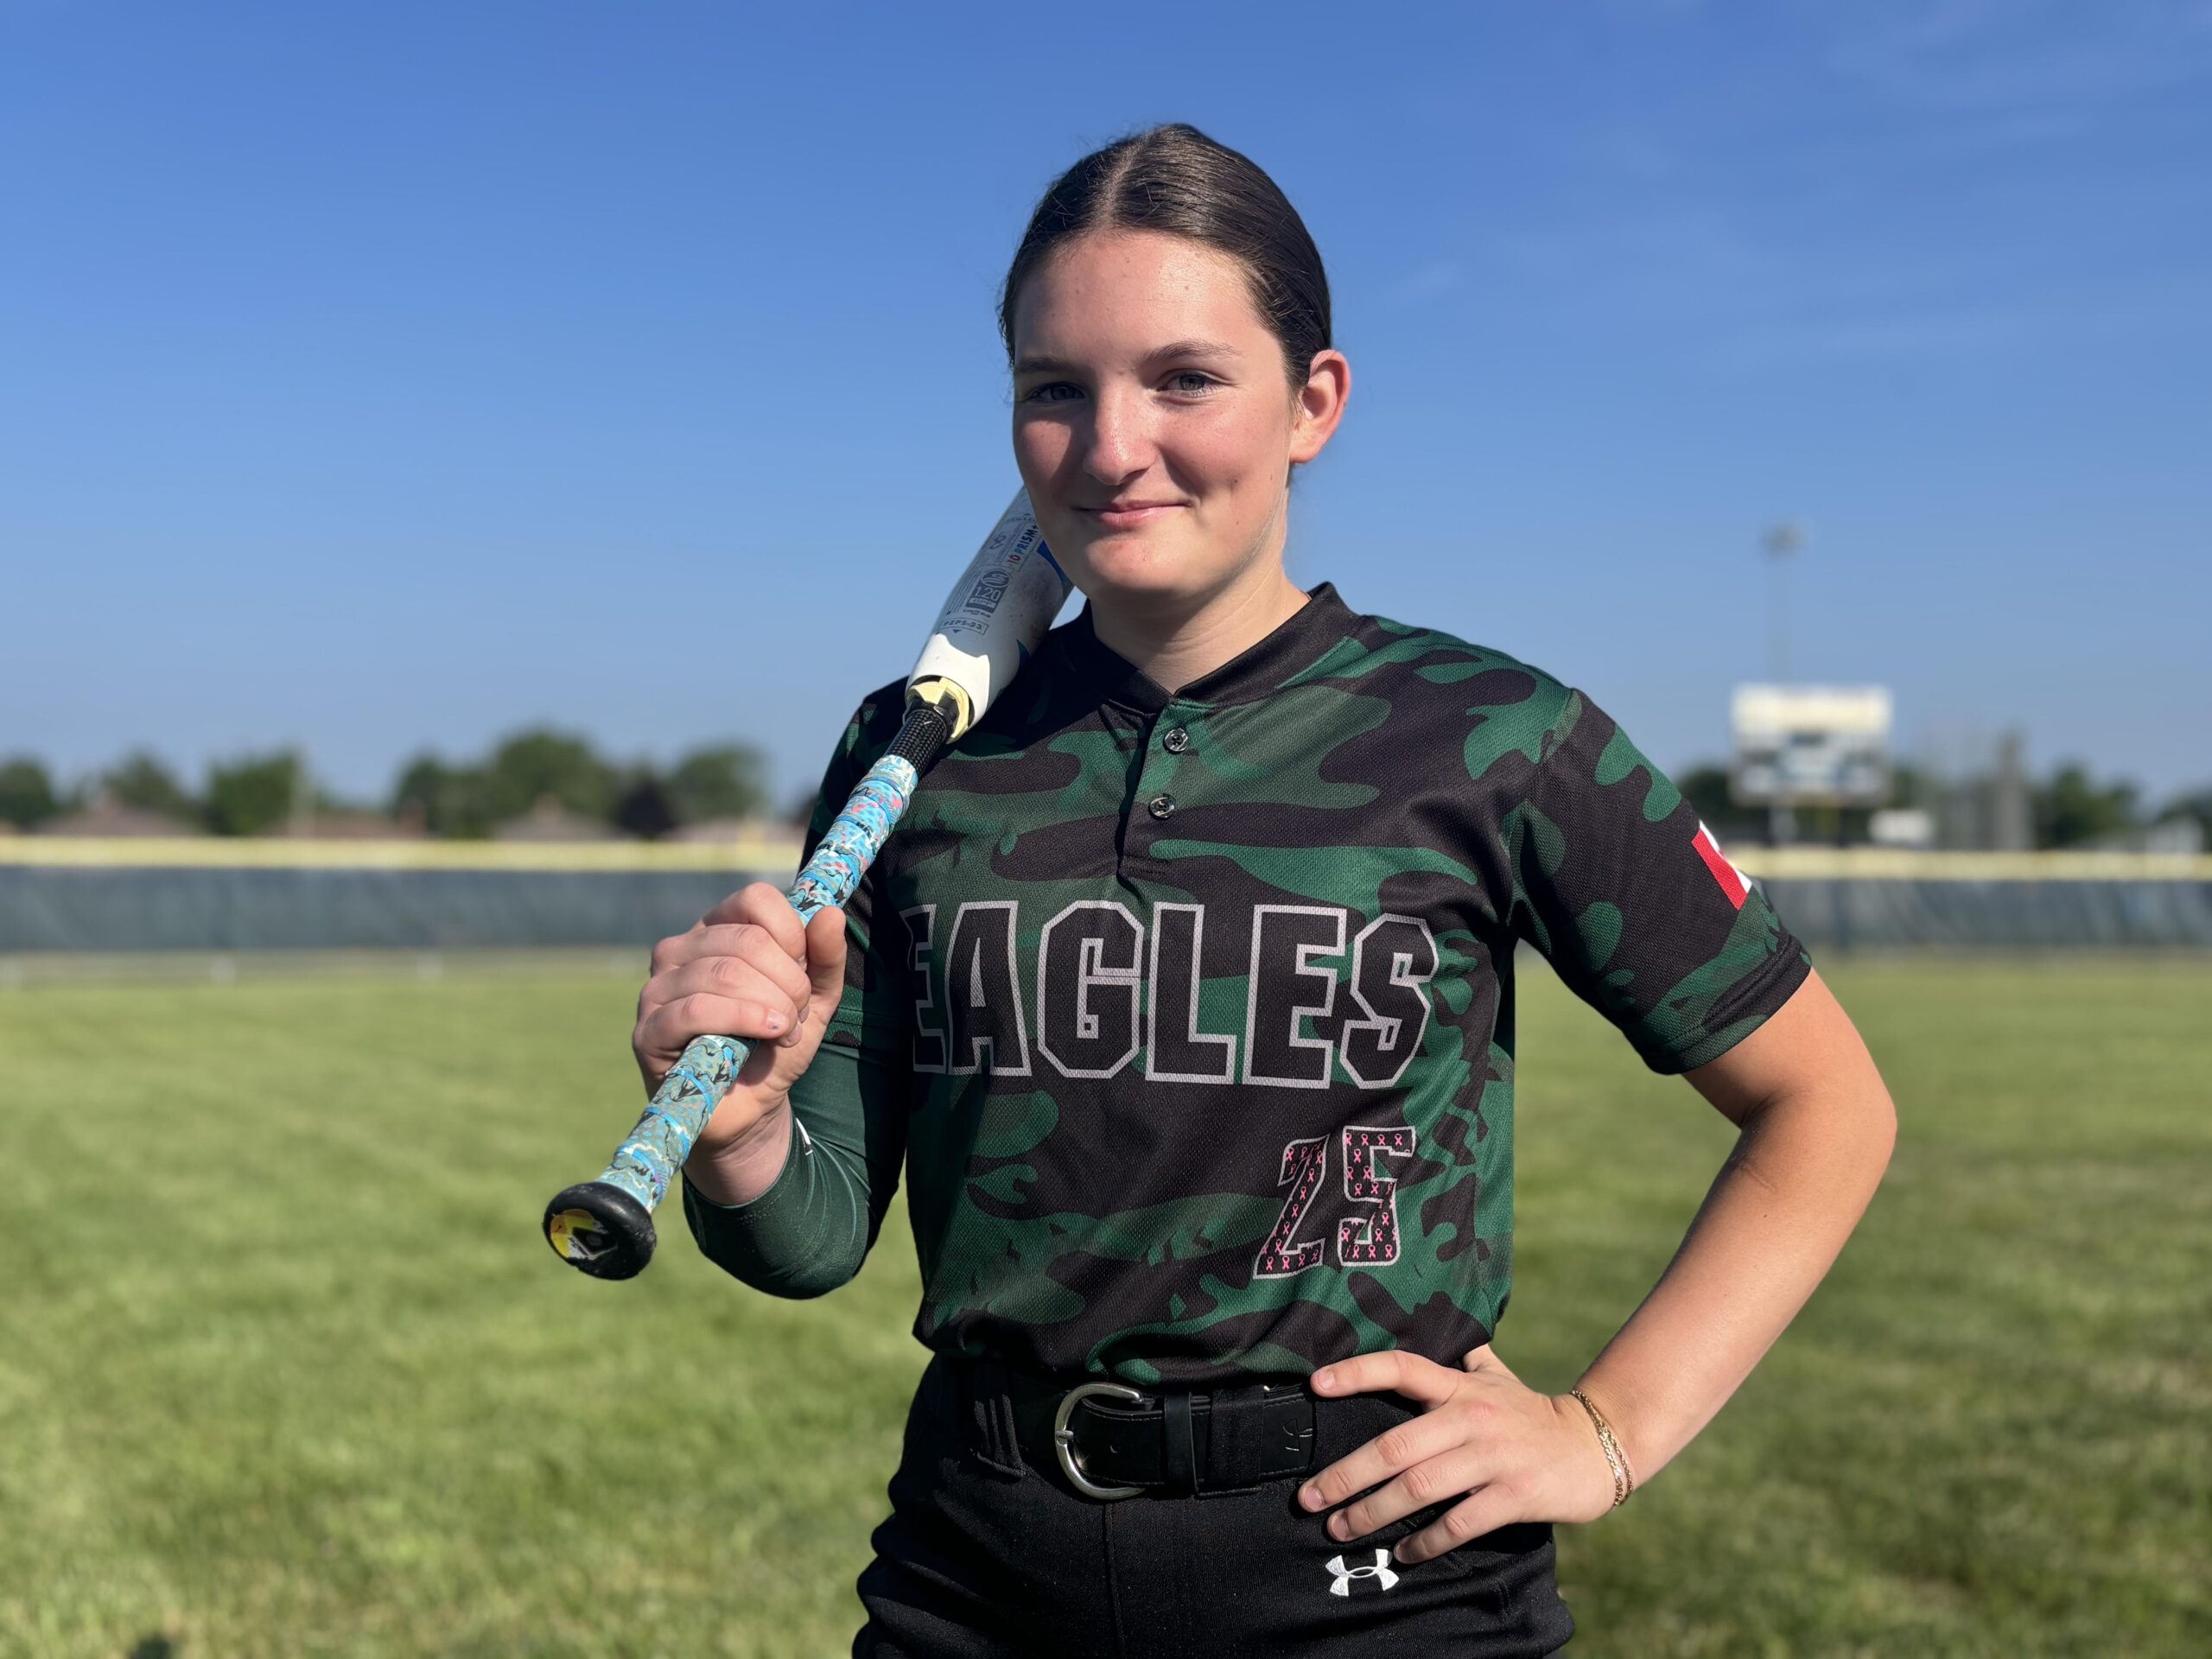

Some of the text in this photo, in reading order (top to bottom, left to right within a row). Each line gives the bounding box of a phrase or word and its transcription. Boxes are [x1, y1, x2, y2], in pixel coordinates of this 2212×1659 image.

[1014, 524, 1039, 555] PRISM+
[899, 900, 1440, 1090] EAGLES
[1253, 1125, 1416, 1280] 25
